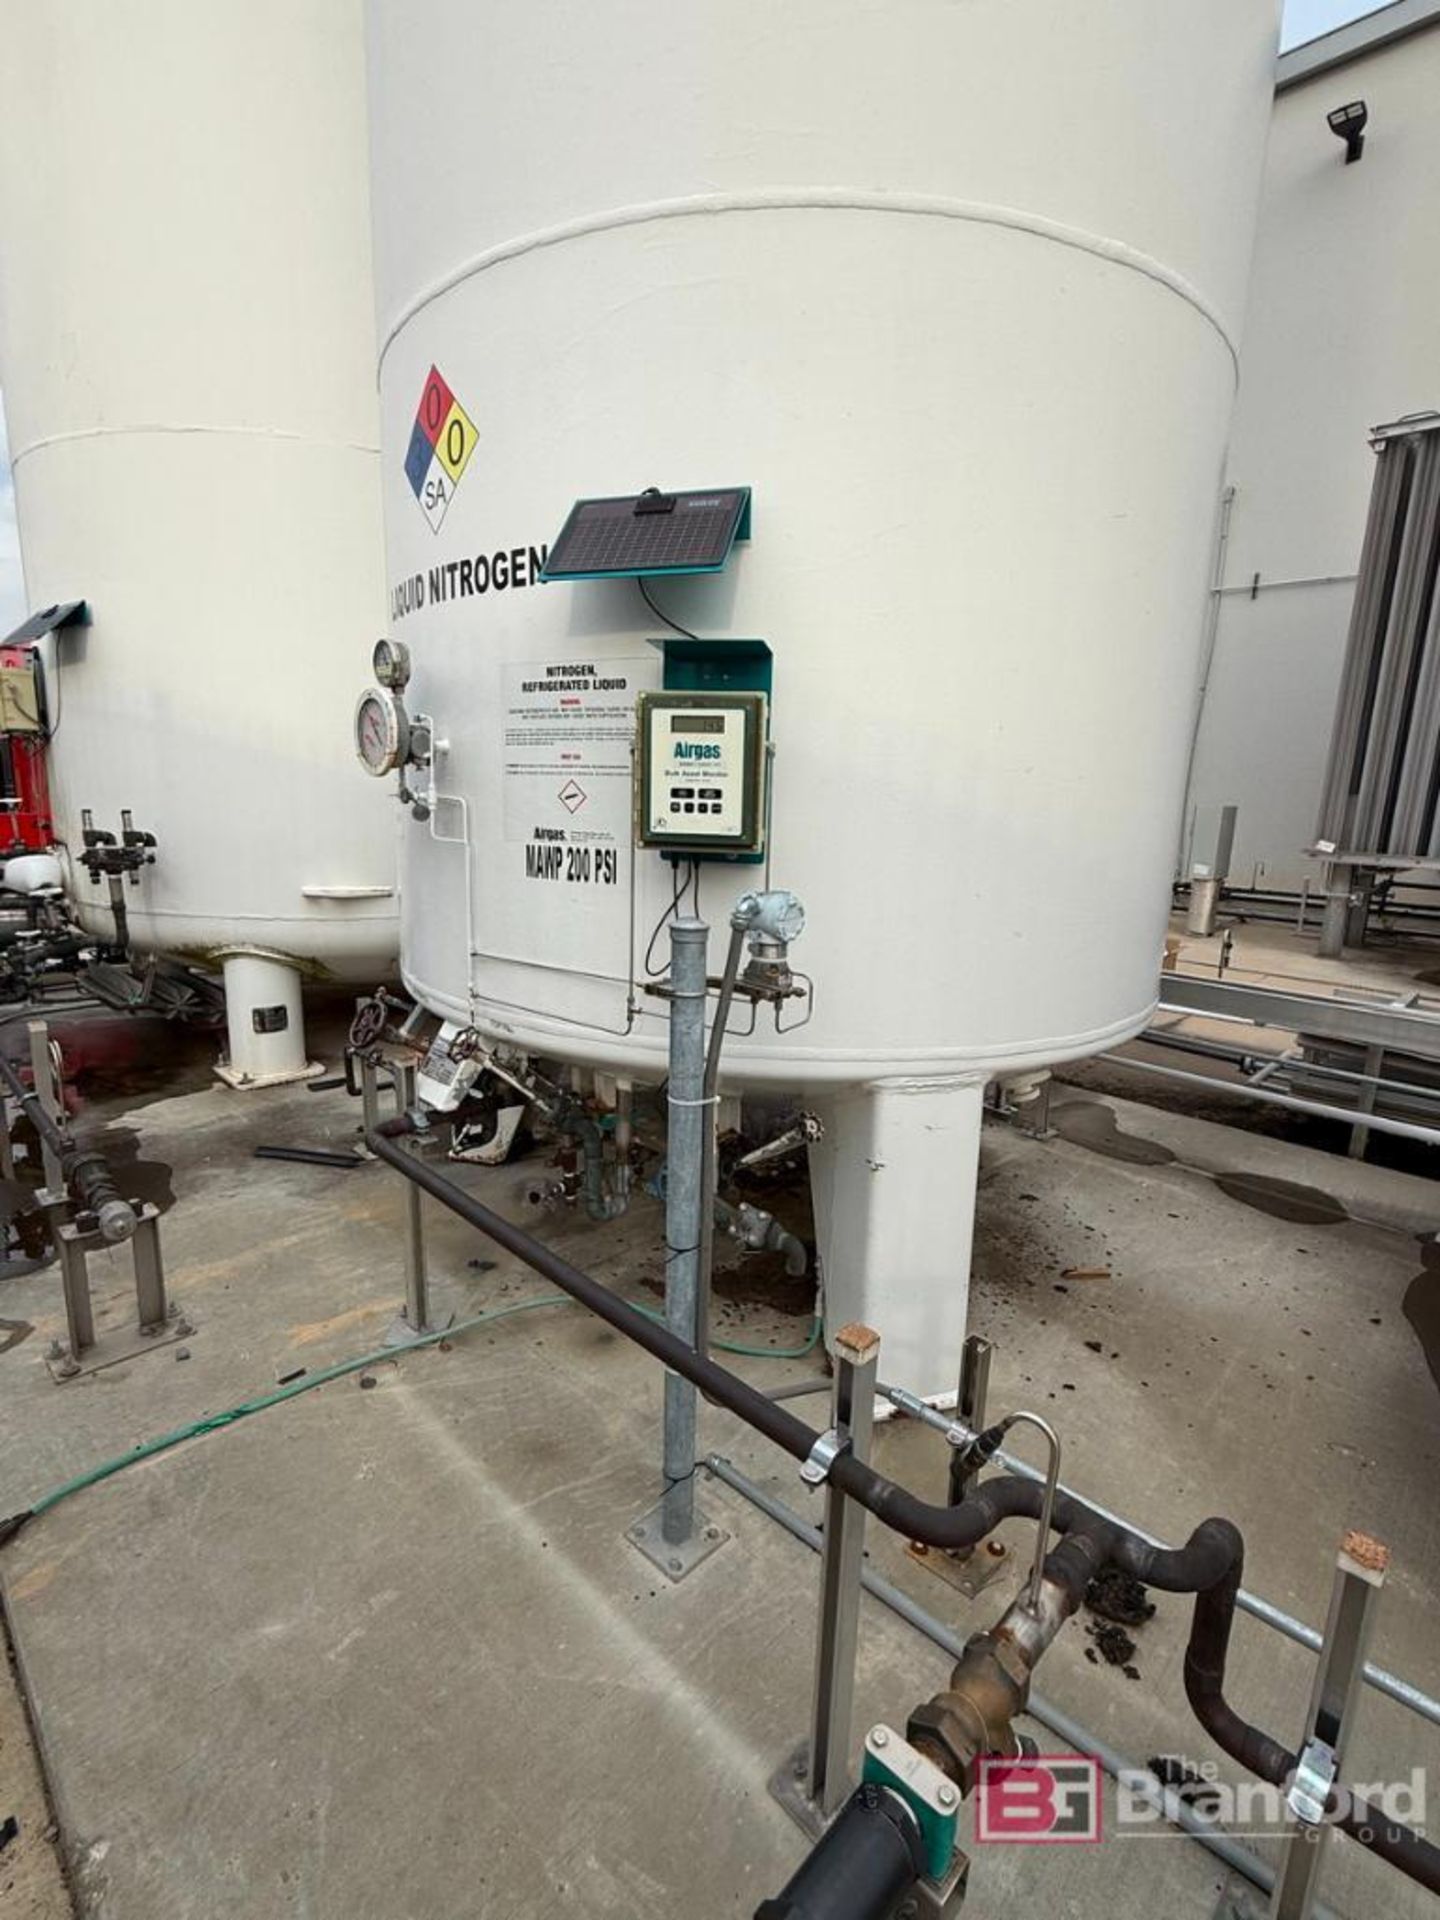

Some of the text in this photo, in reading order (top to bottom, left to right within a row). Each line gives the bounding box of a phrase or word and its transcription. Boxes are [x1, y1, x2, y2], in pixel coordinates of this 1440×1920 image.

[426, 384, 441, 429] 0
[447, 419, 464, 466] 0
[425, 477, 447, 510] SA
[391, 544, 548, 621] LIQUID NITROGEN
[522, 678, 627, 693] REFRIGERATED LIQUID
[674, 741, 721, 760] Airgas
[525, 844, 617, 885] MAWP 200 PSI
